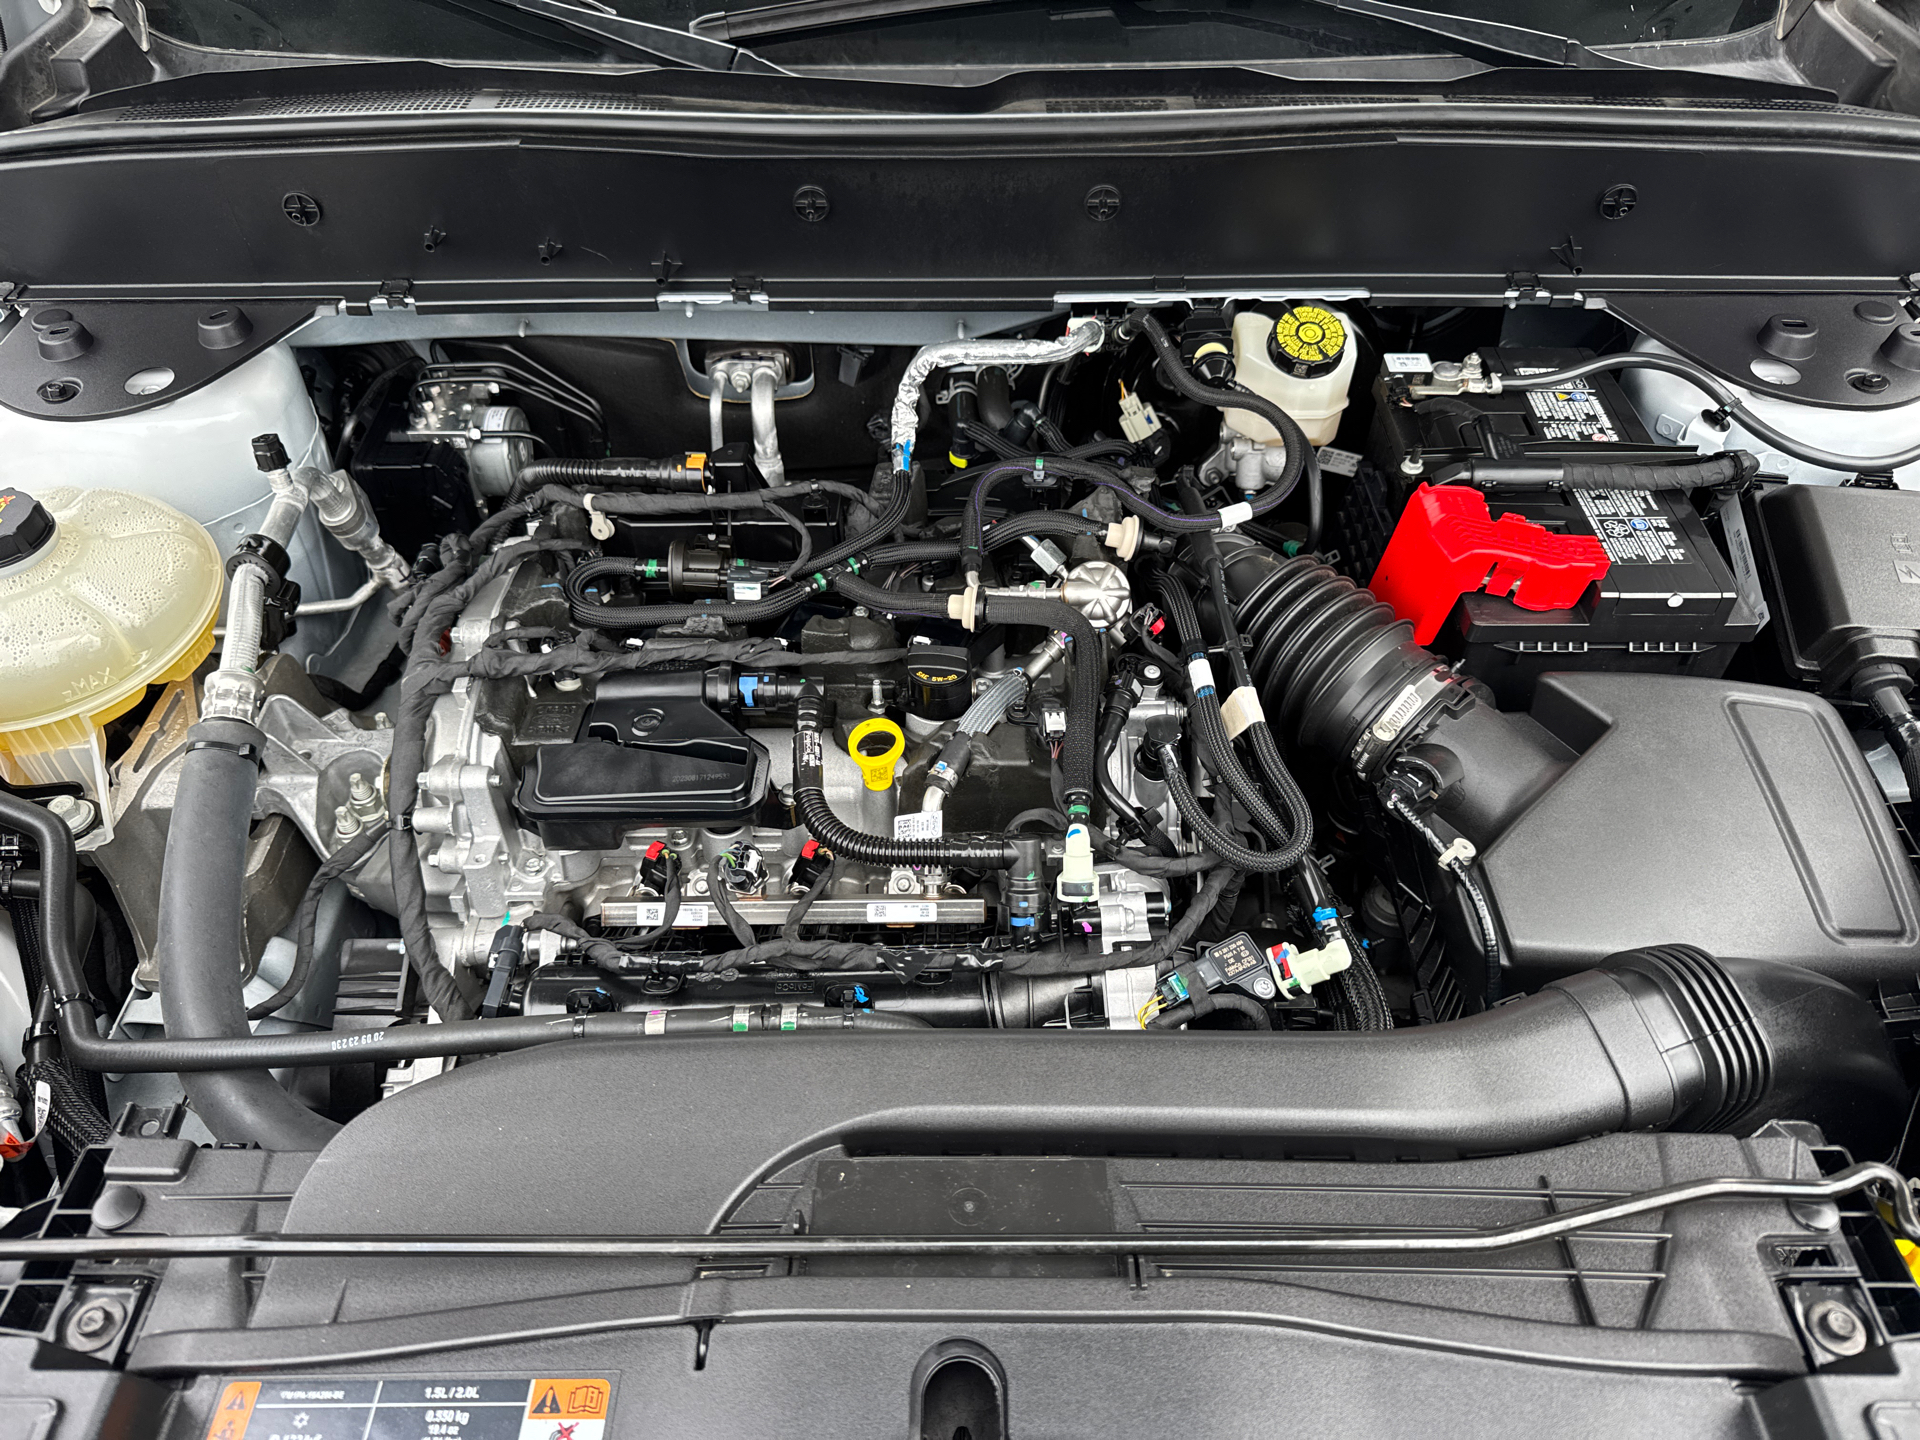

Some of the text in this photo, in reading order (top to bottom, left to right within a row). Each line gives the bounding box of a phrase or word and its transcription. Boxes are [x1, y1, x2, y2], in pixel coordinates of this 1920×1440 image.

[70, 667, 118, 695] MAX
[916, 670, 958, 682] SAE 5W-20
[331, 1031, 385, 1050] 20 09 23 230
[424, 1386, 448, 1399] 1.5L
[454, 1386, 480, 1399] 2.0L
[454, 1409, 470, 1425] kg
[446, 1425, 460, 1435] oz
